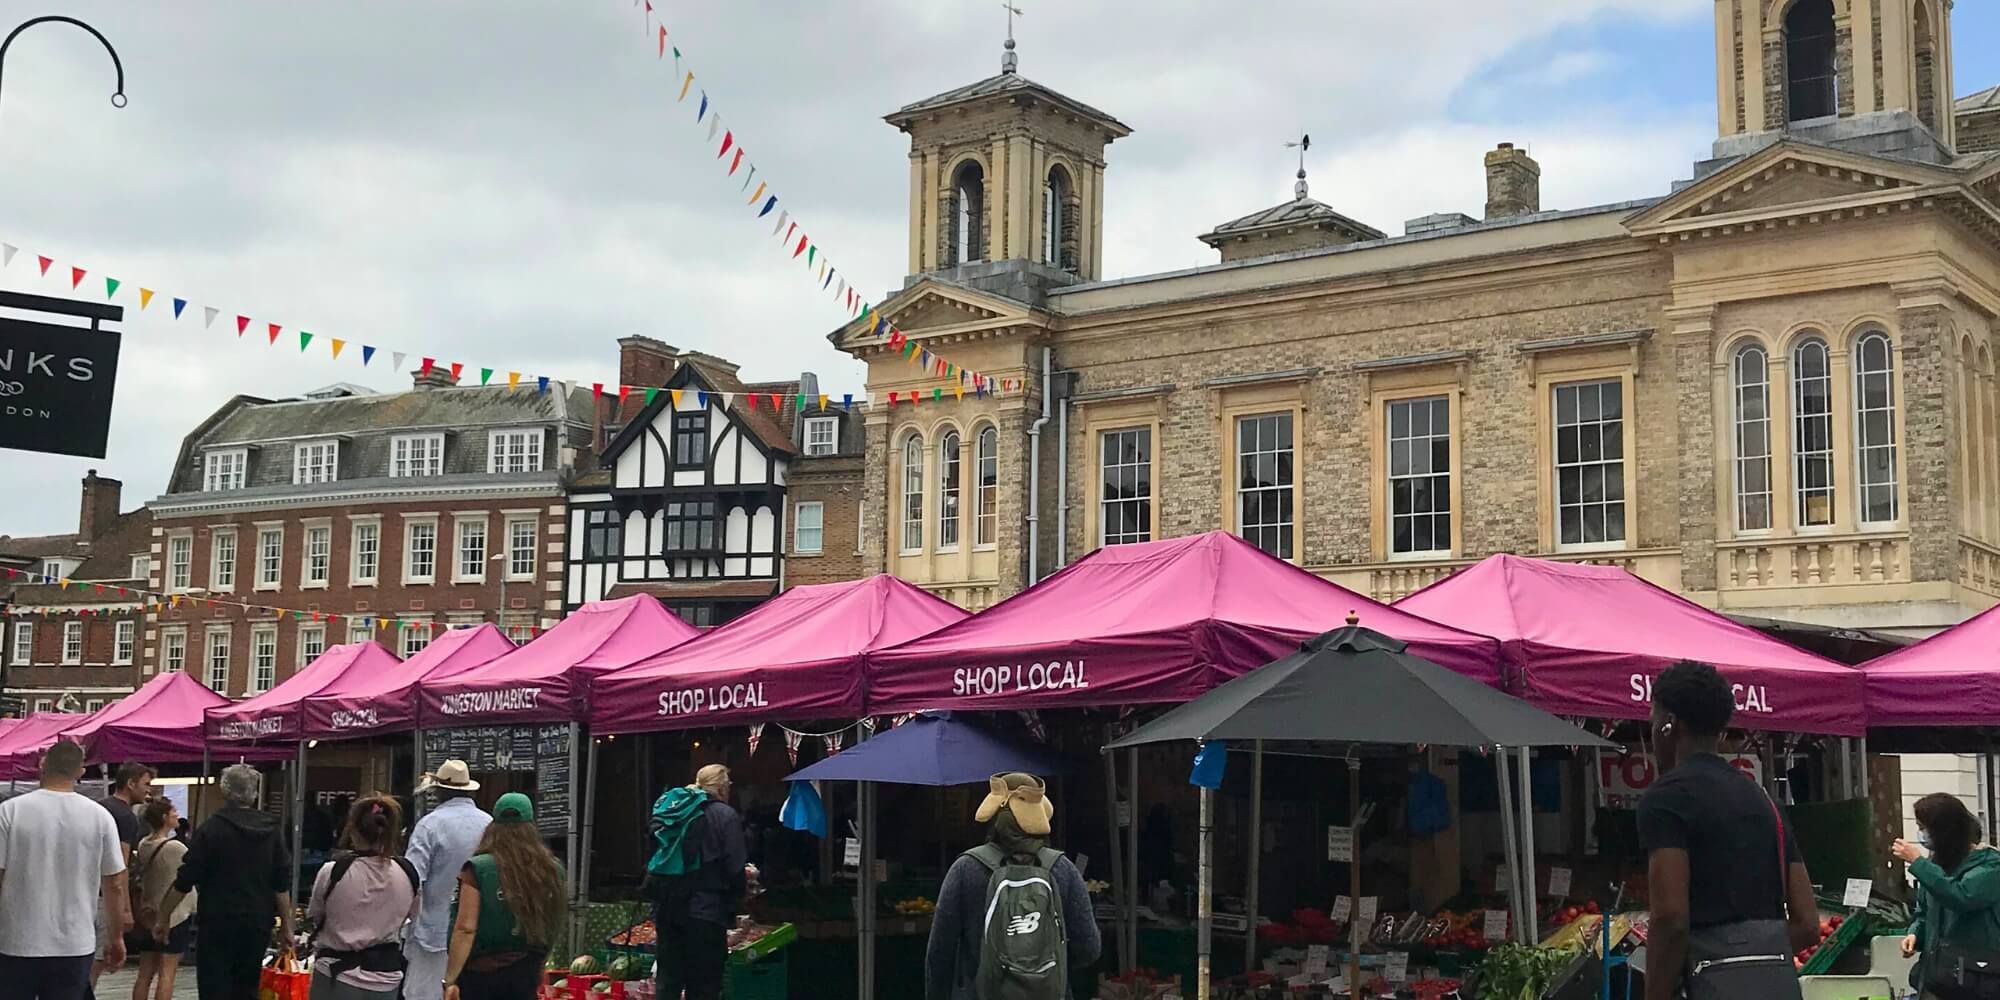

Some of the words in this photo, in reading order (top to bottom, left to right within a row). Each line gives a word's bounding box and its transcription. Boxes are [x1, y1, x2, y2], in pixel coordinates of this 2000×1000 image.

[953, 666, 1011, 695] SHOP
[1016, 660, 1089, 691] LOCAL
[440, 691, 492, 714] KINGSTON
[493, 688, 542, 711] MARKET
[657, 688, 705, 715] SHOP
[708, 682, 769, 710] LOCAL
